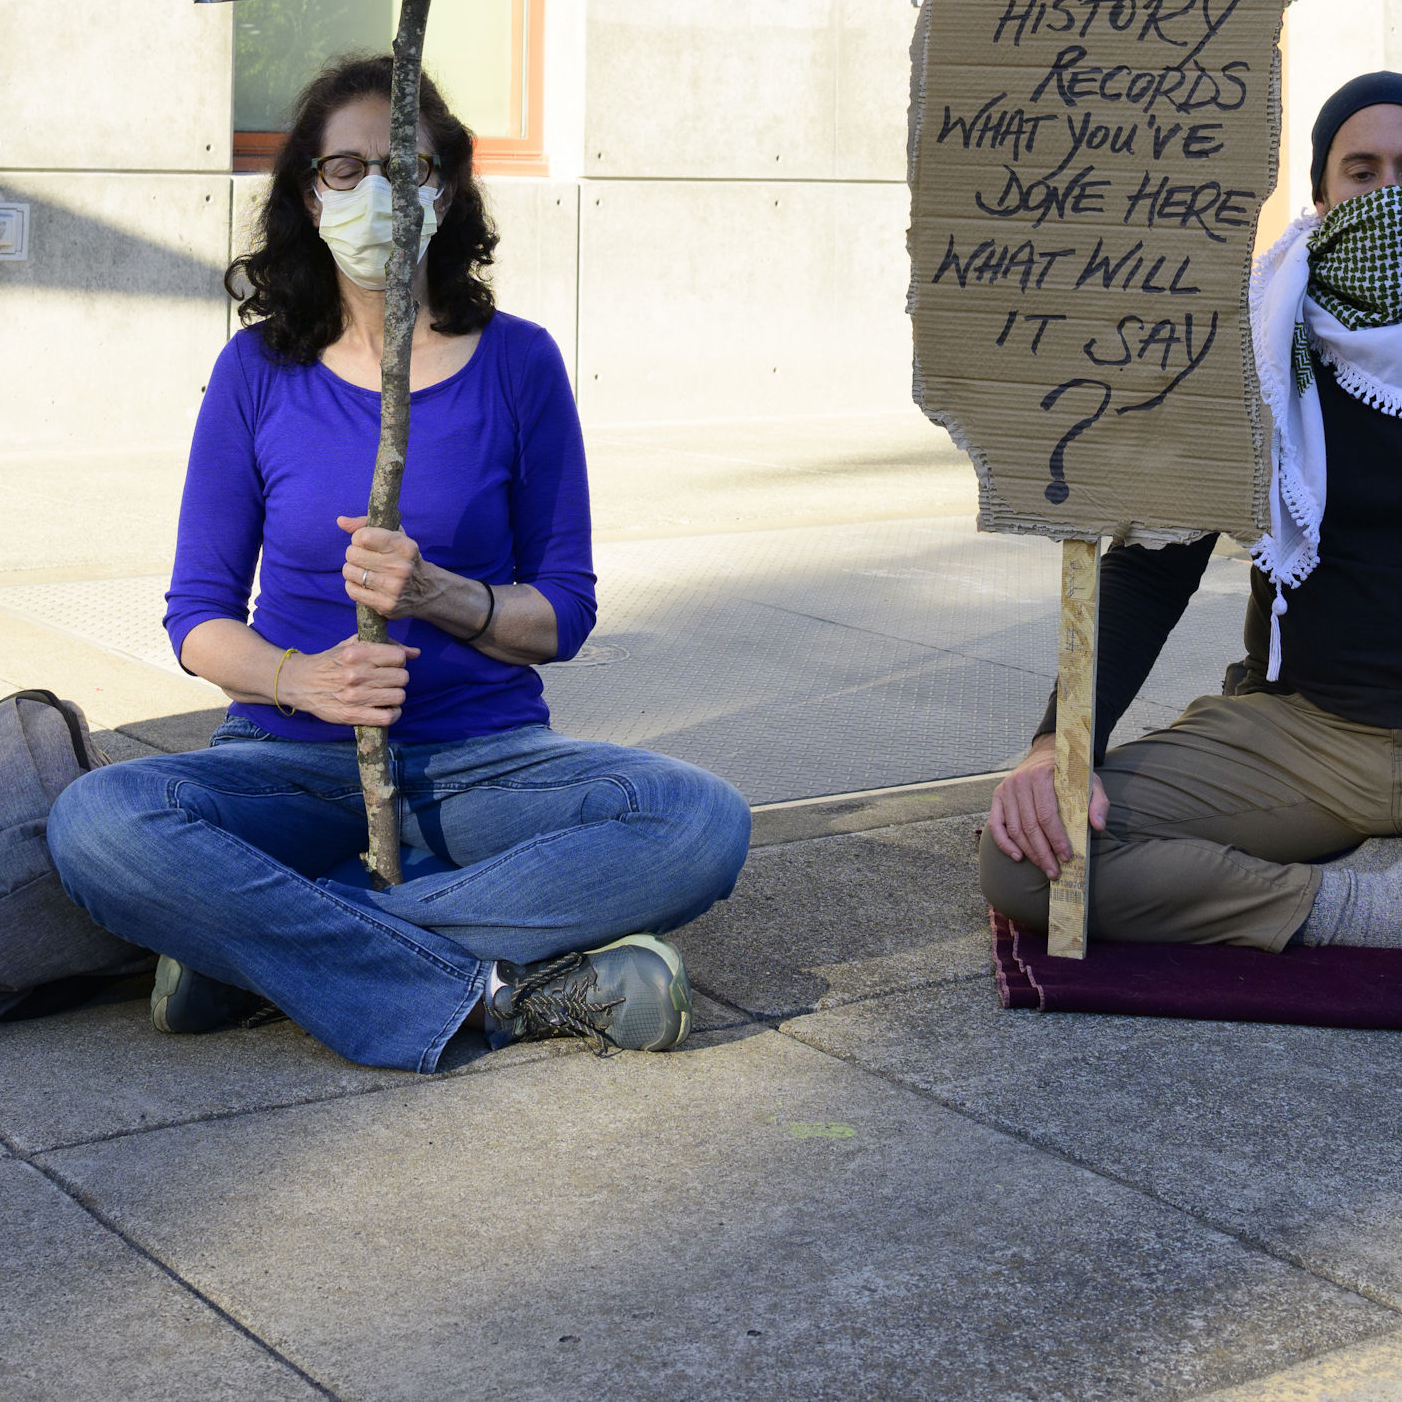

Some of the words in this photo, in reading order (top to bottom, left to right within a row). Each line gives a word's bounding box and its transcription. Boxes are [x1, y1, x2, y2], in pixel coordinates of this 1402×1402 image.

[1030, 45, 1250, 114] RECORDS
[937, 93, 1058, 161] WHAT
[975, 165, 1111, 228] DONE
[1124, 170, 1256, 243] HERE
[932, 234, 1076, 294] WHAT
[1073, 236, 1201, 295] WILL
[996, 310, 1067, 355] IT
[1083, 311, 1218, 415] SAY
[1040, 379, 1112, 505] ?
